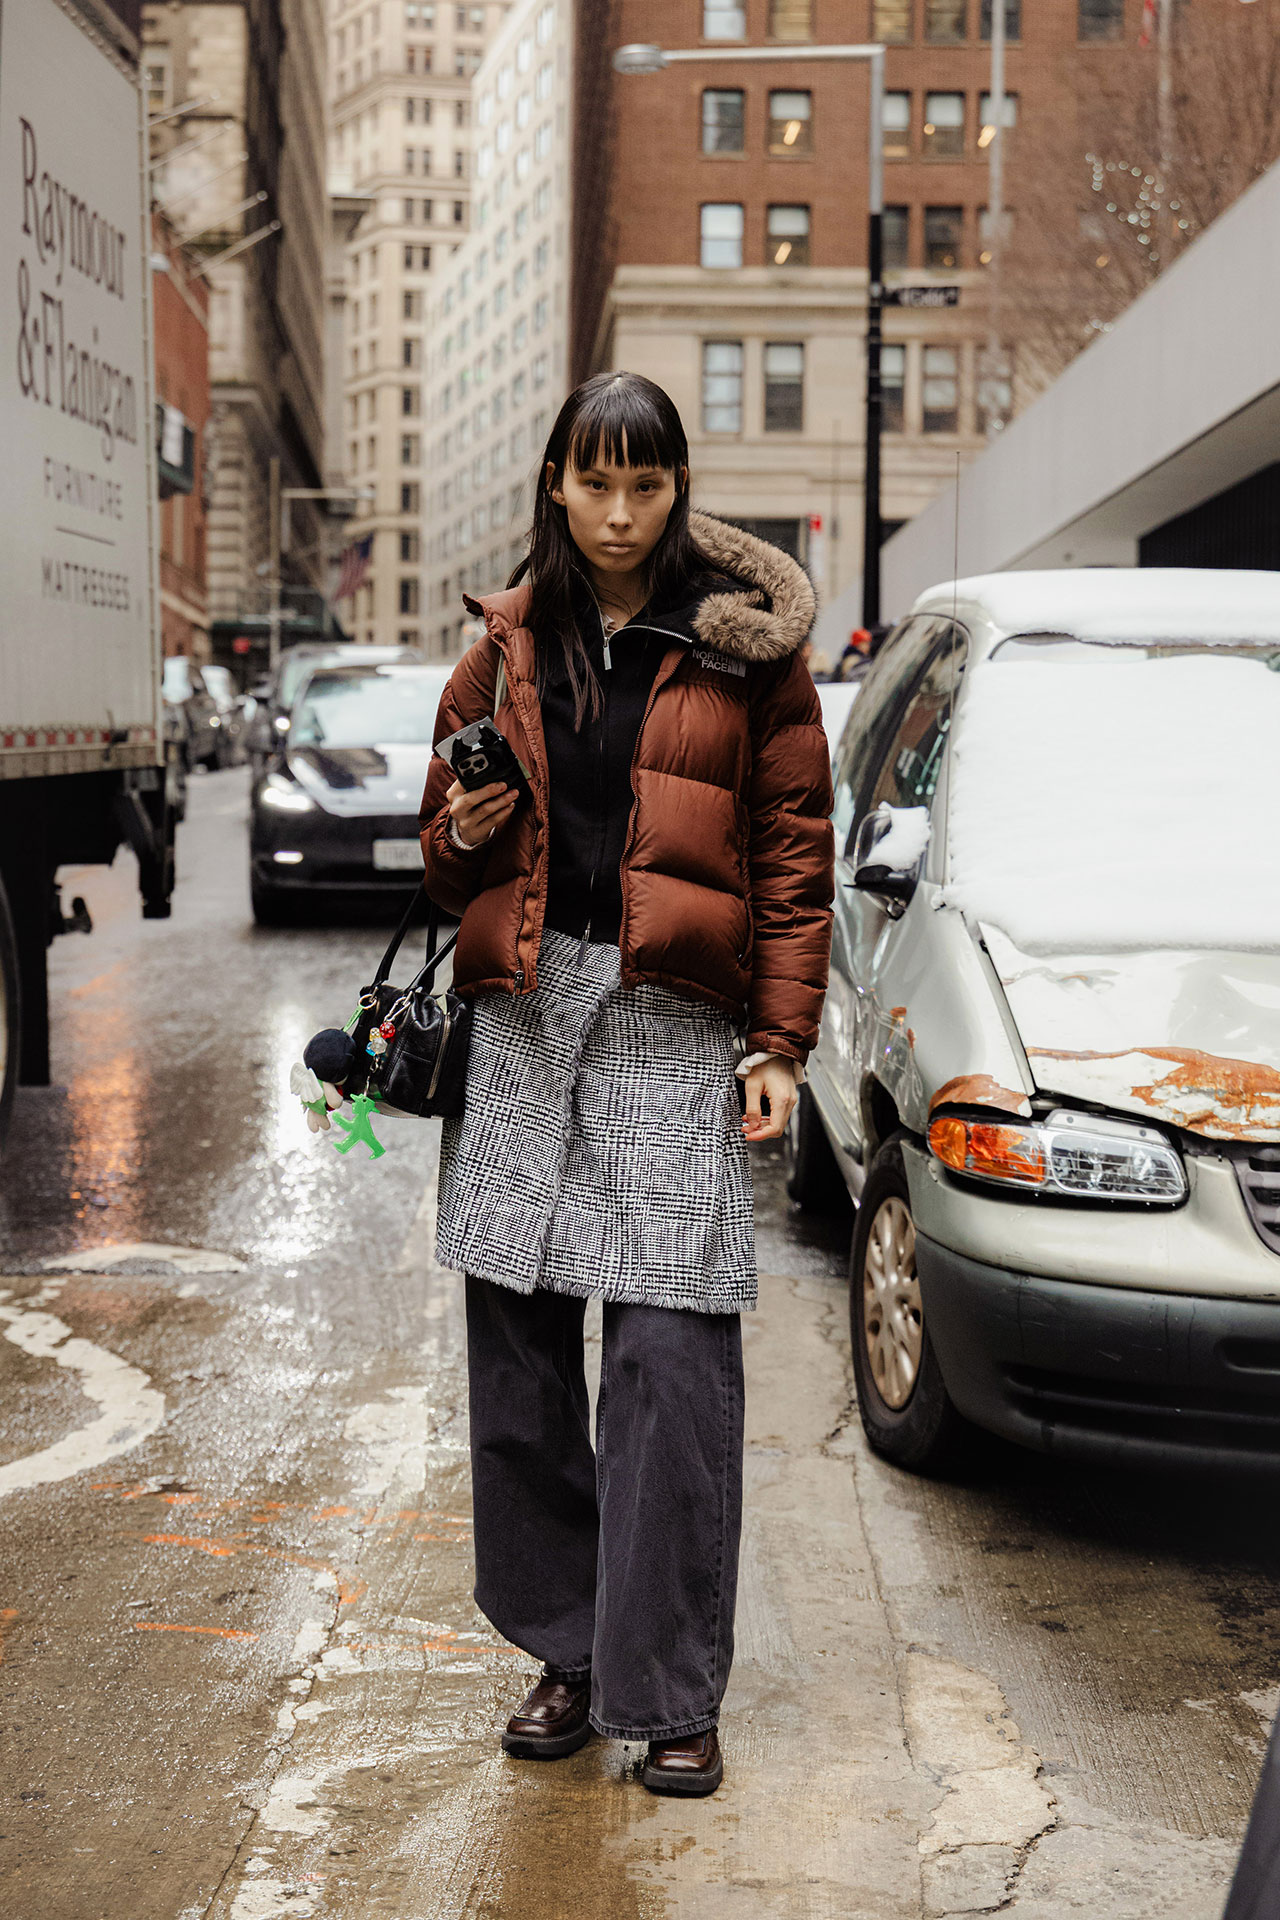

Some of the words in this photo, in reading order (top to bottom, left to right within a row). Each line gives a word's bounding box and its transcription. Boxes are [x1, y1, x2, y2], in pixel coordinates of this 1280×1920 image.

[18, 116, 126, 300] Raymour
[43, 456, 123, 520] FURNITURE
[41, 557, 129, 611] MATTRESSES
[692, 649, 729, 662] NORTH
[701, 660, 728, 673] FACE
